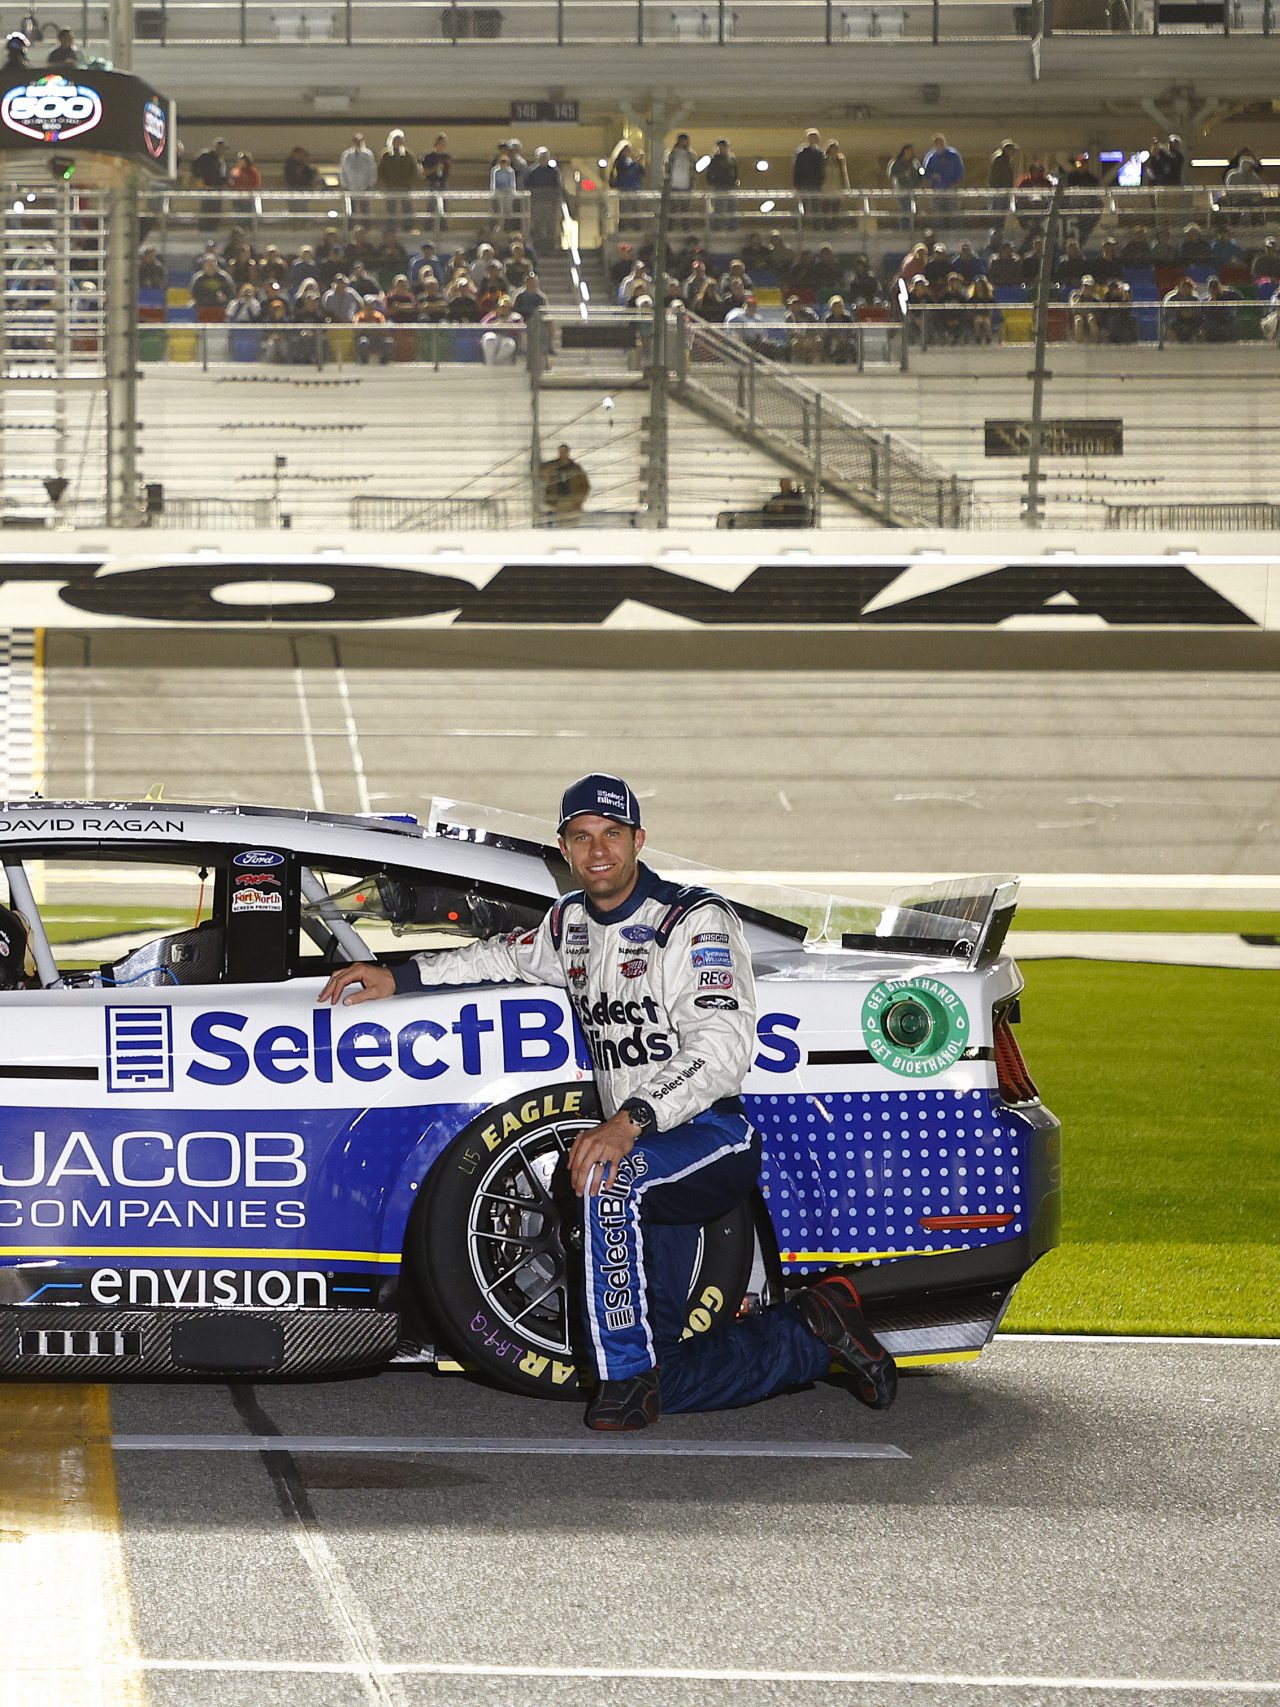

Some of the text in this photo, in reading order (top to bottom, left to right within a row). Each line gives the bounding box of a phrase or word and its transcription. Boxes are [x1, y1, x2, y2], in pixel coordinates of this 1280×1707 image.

[10, 97, 94, 119] 500
[83, 819, 184, 832] RAGAN
[243, 852, 274, 863] Ford
[234, 892, 280, 904] Fort Worth
[700, 933, 728, 943] NASCAR
[868, 988, 887, 1010] GET
[870, 1038, 964, 1074] GET BIOETHANOL
[481, 1091, 583, 1152] EAGLE
[90, 1267, 327, 1306] envision
